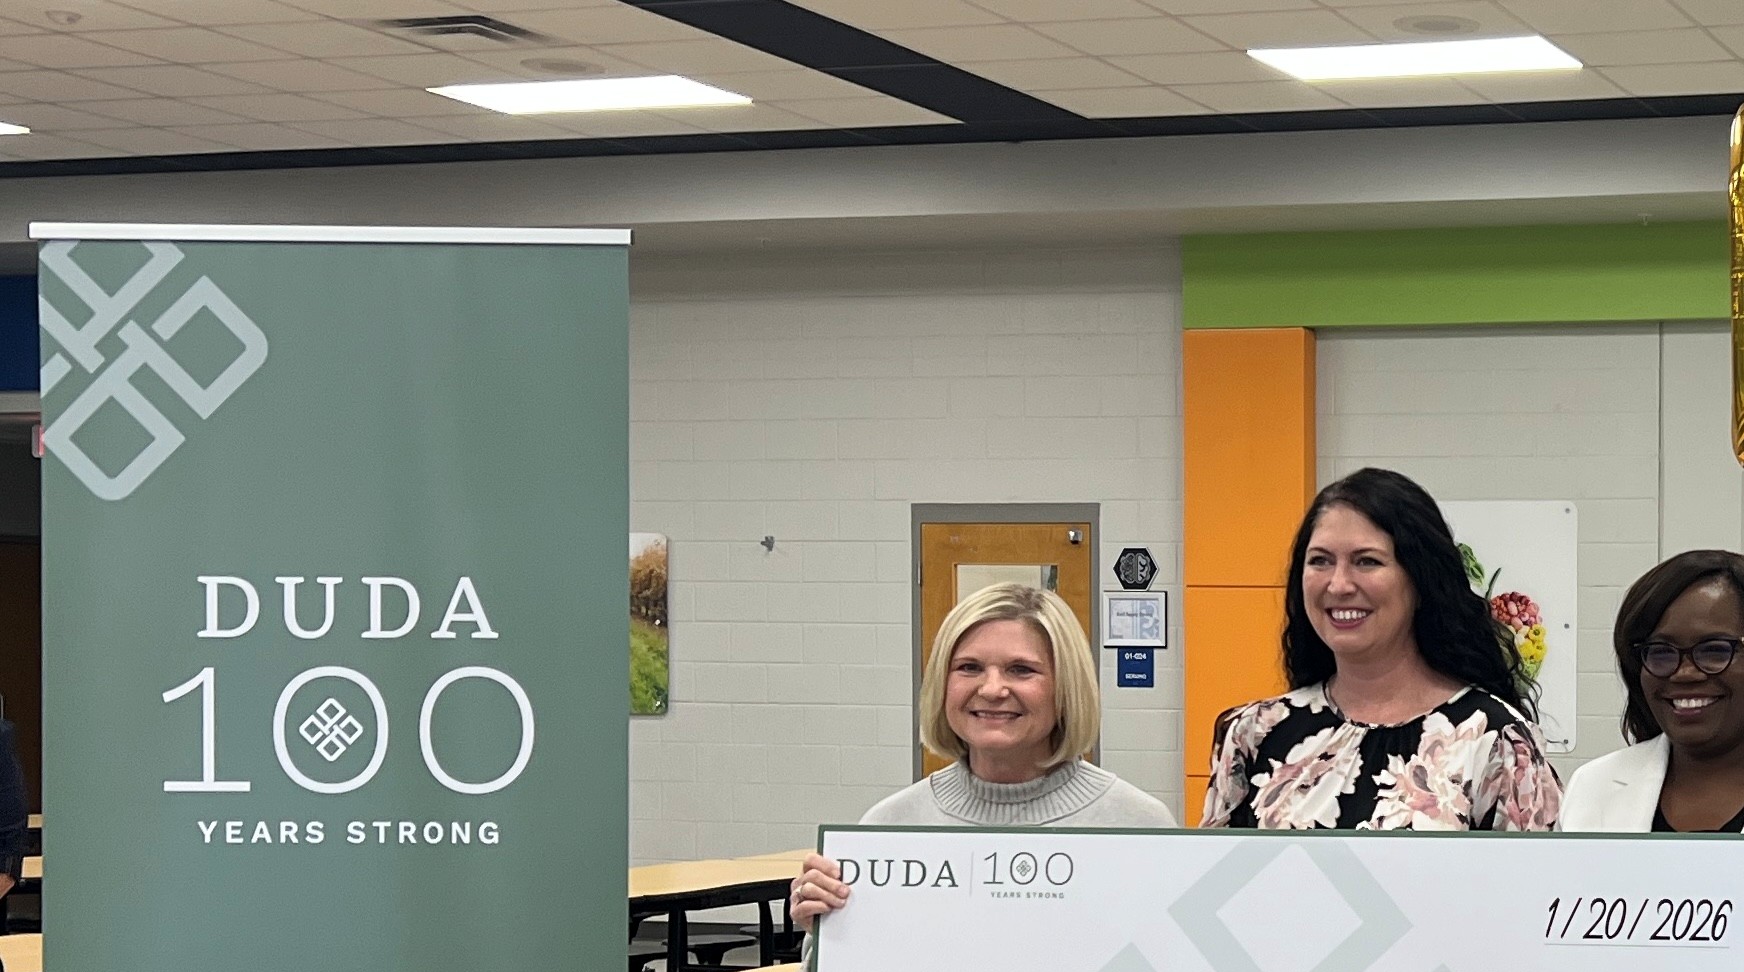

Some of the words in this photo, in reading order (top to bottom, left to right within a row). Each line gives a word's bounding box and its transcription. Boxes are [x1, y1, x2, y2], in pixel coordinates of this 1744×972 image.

[196, 575, 499, 640] DUDA
[162, 666, 535, 795] 100
[197, 820, 325, 844] YEARS
[346, 820, 500, 845] STRONG
[836, 858, 960, 888] DUDA
[982, 851, 1075, 887] 100
[990, 891, 1021, 900] YEARS
[1026, 891, 1066, 900] STRONG
[1545, 896, 1734, 941] 1/20/2026
